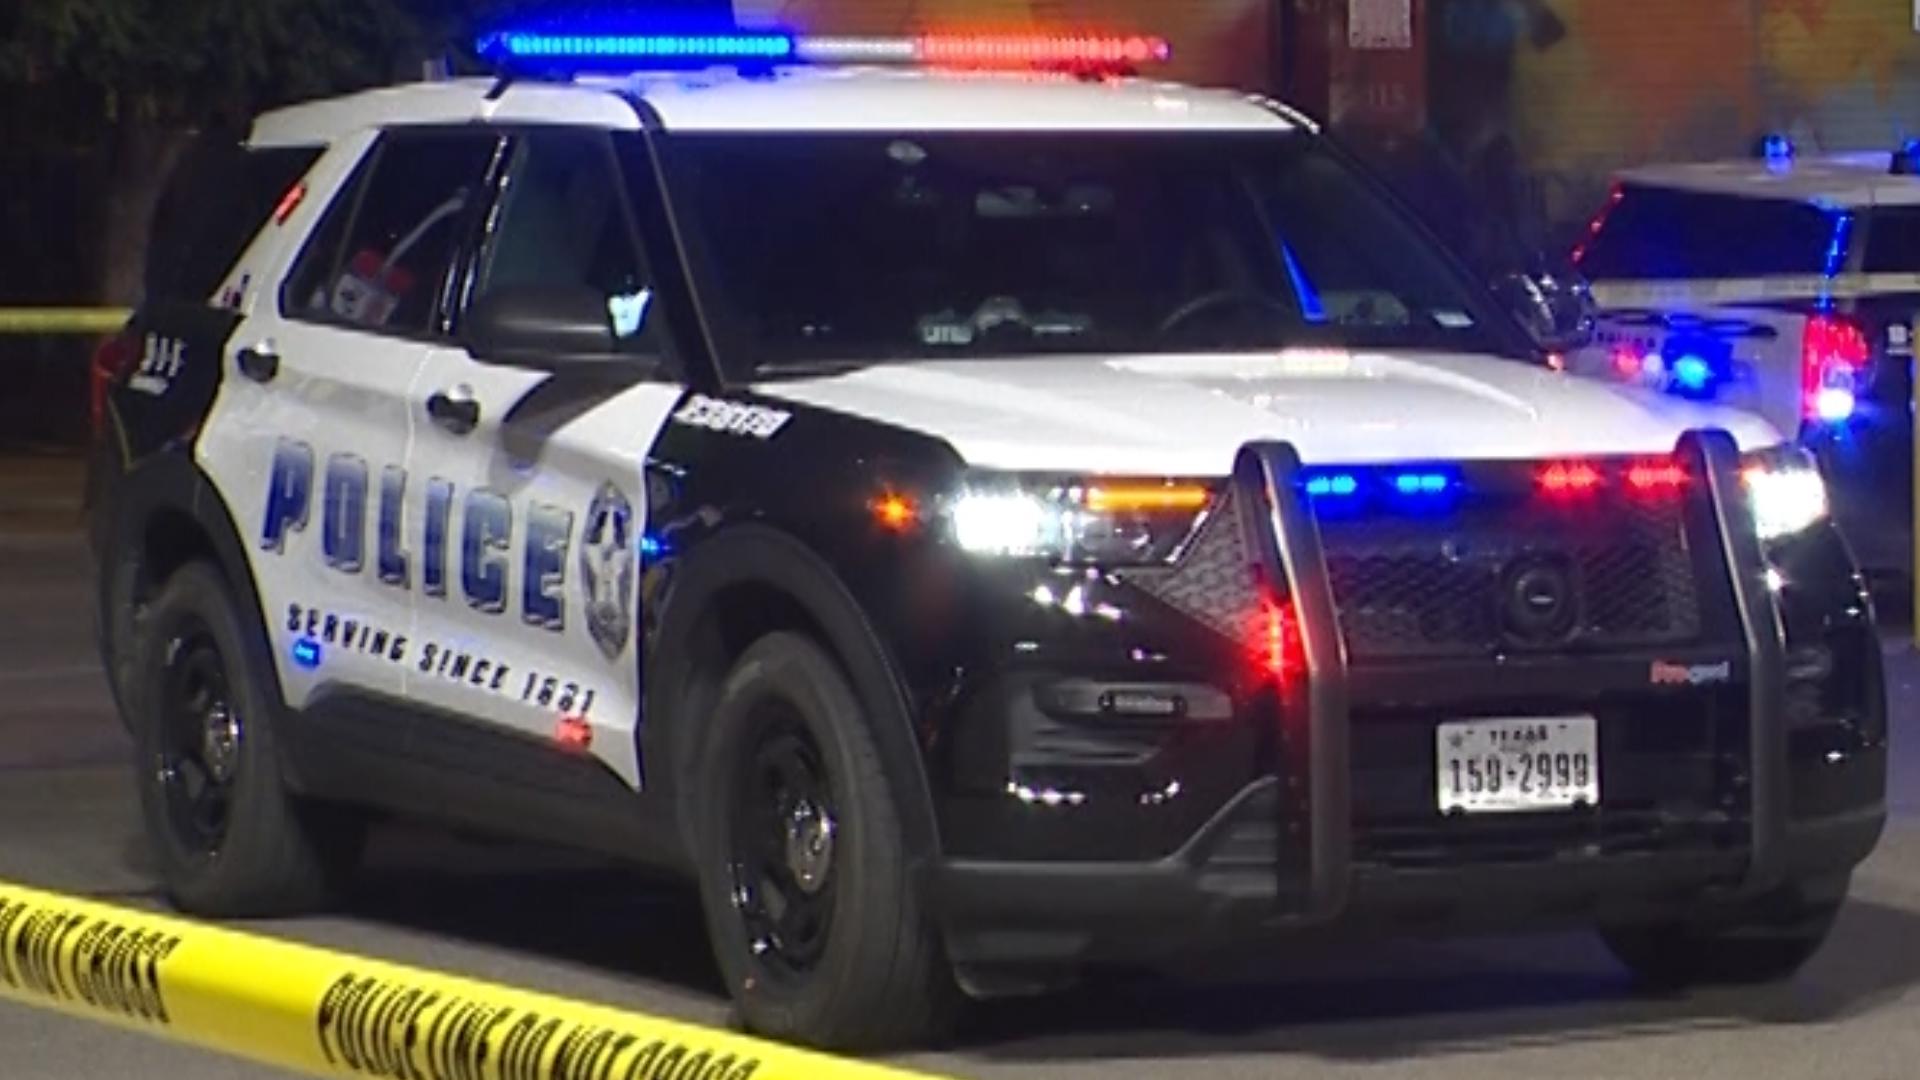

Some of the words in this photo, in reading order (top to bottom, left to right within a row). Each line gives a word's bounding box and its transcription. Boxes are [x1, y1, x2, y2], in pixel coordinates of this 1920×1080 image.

[260, 436, 574, 632] POLICE
[286, 603, 408, 661] SERVING
[419, 642, 510, 689] SINCE
